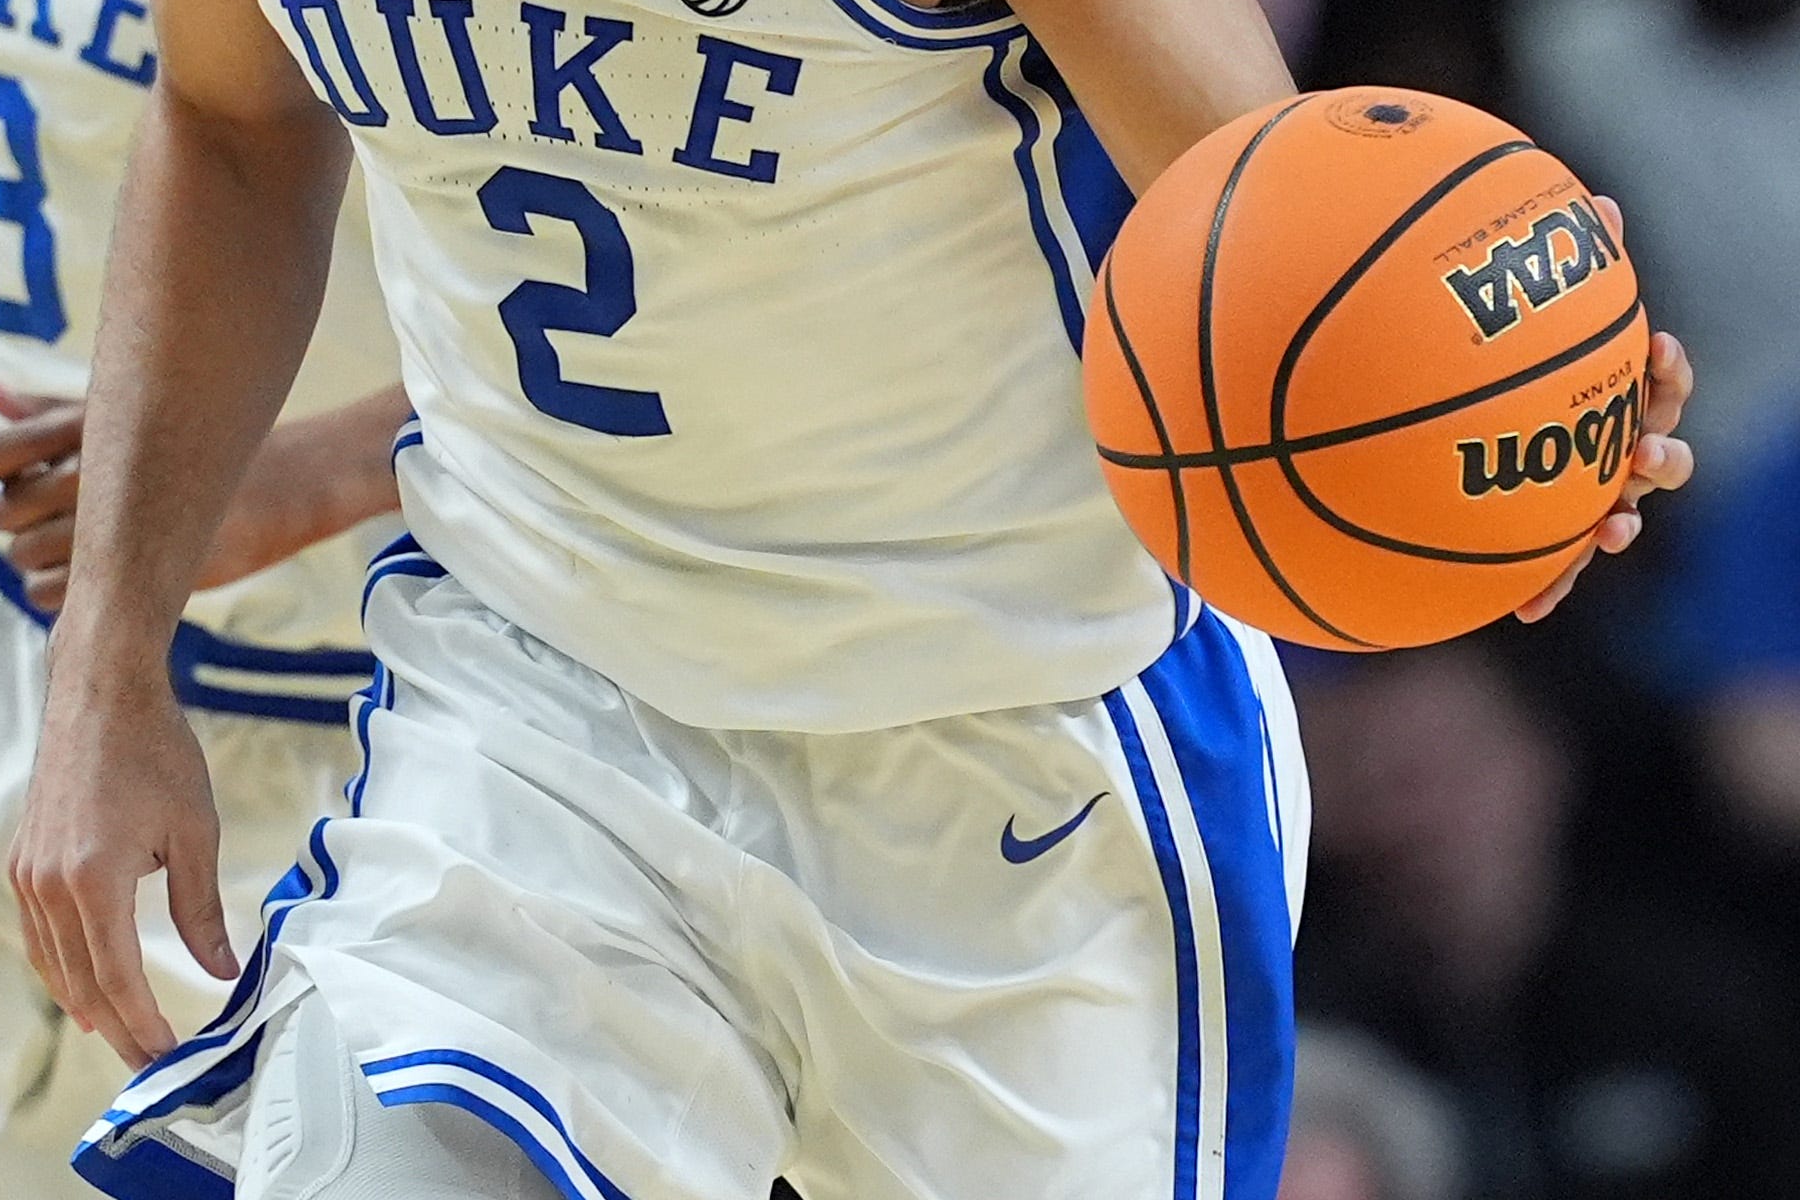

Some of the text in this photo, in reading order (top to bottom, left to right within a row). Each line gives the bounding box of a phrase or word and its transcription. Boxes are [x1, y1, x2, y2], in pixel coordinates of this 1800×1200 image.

[476, 164, 673, 438] 2
[1433, 230, 1488, 265] BALL
[1441, 196, 1621, 341] NCAA
[1454, 376, 1641, 497] ilson
[1568, 386, 1604, 409] NXT
